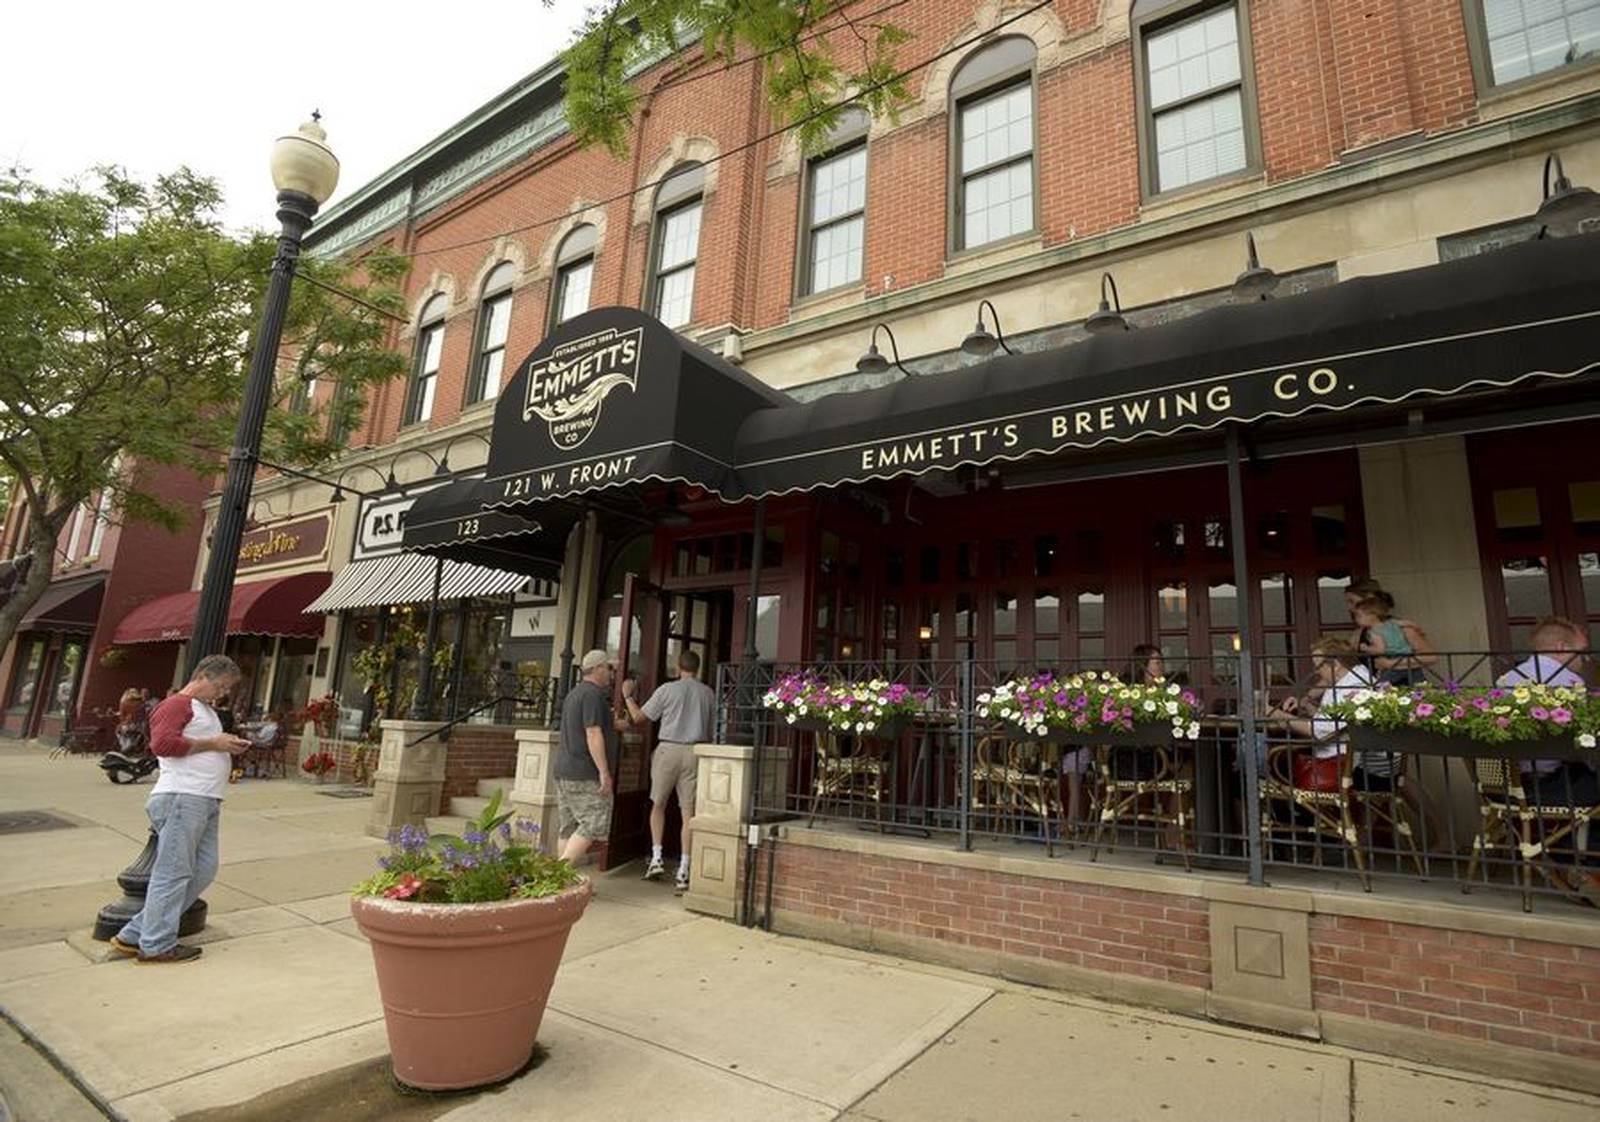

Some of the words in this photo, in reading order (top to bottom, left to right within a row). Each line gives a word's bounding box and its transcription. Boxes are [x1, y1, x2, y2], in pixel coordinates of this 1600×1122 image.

[529, 339, 637, 404] EMMETT'S
[553, 417, 593, 435] BREWING
[861, 424, 1019, 471] EMMETT'S
[1051, 386, 1233, 439] BREWING
[1273, 368, 1356, 400] CO.
[565, 432, 578, 443] CO
[504, 477, 531, 497] 121
[541, 472, 560, 490] W.
[569, 456, 637, 485] FRONT
[457, 519, 480, 537] 123
